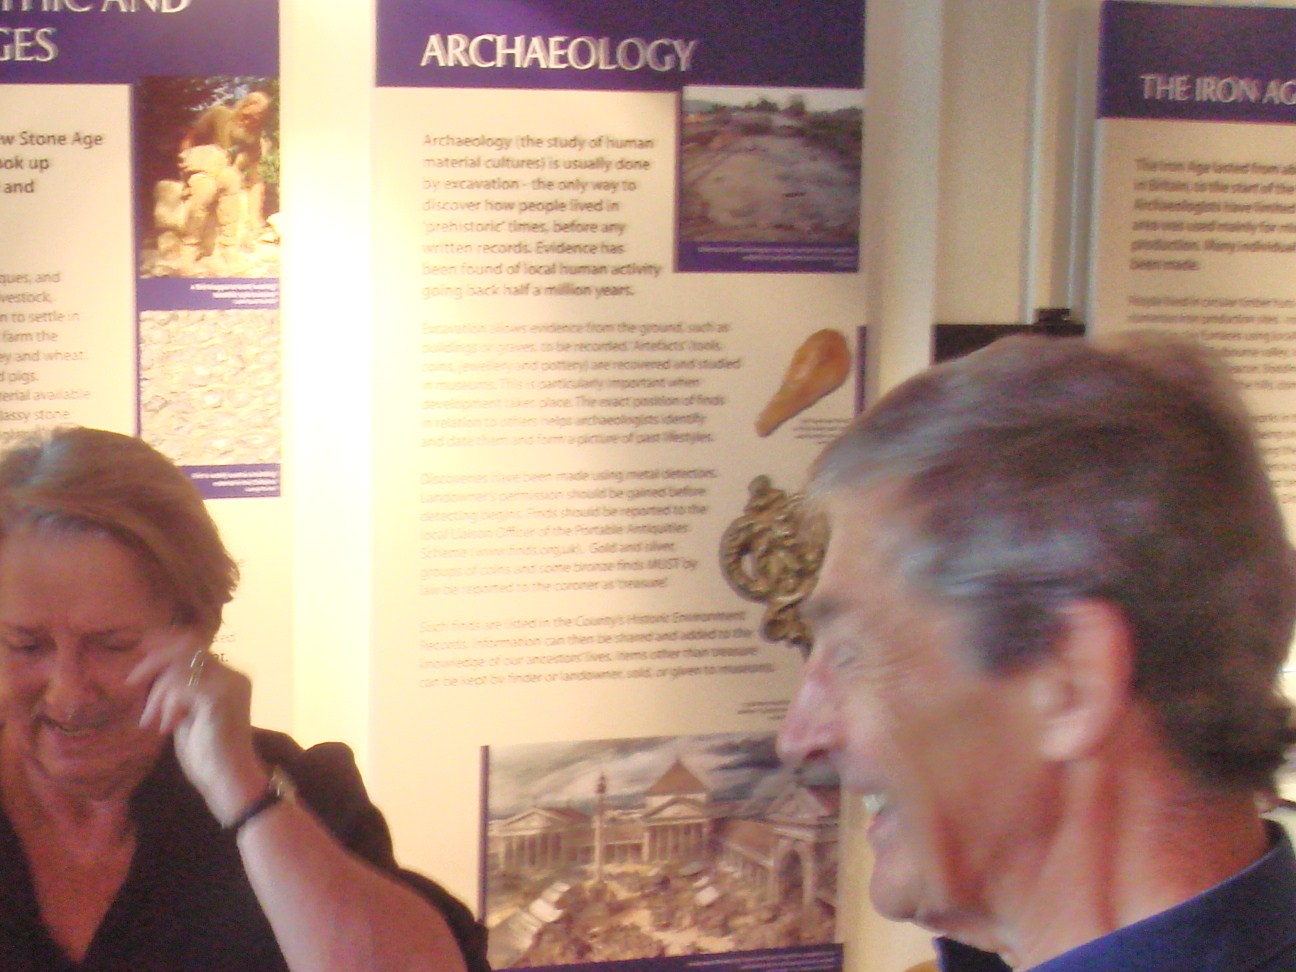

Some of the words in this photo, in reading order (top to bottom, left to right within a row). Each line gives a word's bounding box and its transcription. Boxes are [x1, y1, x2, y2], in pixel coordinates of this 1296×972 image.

[420, 33, 698, 72] ARCHAEOLOGY
[1138, 73, 1192, 100] THE
[1195, 75, 1261, 103] IRON
[19, 131, 66, 146] Stone
[72, 130, 103, 149] Age
[423, 134, 512, 151] Archaeology
[547, 135, 585, 152] study
[589, 135, 604, 148] of
[606, 135, 654, 148] human
[29, 159, 50, 174] up
[423, 155, 481, 169] material
[485, 156, 545, 173] cultures)
[548, 156, 560, 170] is
[563, 156, 612, 173] usually
[615, 157, 651, 170] done
[4, 179, 35, 194] and
[444, 177, 519, 190] excavation
[531, 177, 554, 191] the
[558, 177, 588, 194] only
[592, 181, 619, 195] way
[622, 179, 637, 191] to
[423, 198, 481, 211] discover
[485, 198, 515, 211] how
[519, 198, 566, 215] people
[570, 198, 604, 212] lived
[607, 198, 619, 212] in
[553, 219, 598, 233] before
[601, 223, 627, 236] any
[422, 240, 473, 254] written
[536, 241, 596, 254] Evidence
[601, 241, 624, 254] has
[422, 262, 456, 275] been
[461, 262, 503, 275] found
[506, 262, 520, 275] of
[524, 261, 556, 275] local
[559, 261, 607, 275] human
[611, 261, 662, 278] activity
[422, 283, 462, 300] going
[467, 283, 498, 296] back
[502, 283, 530, 296] half
[533, 286, 541, 296] a
[544, 282, 592, 296] million
